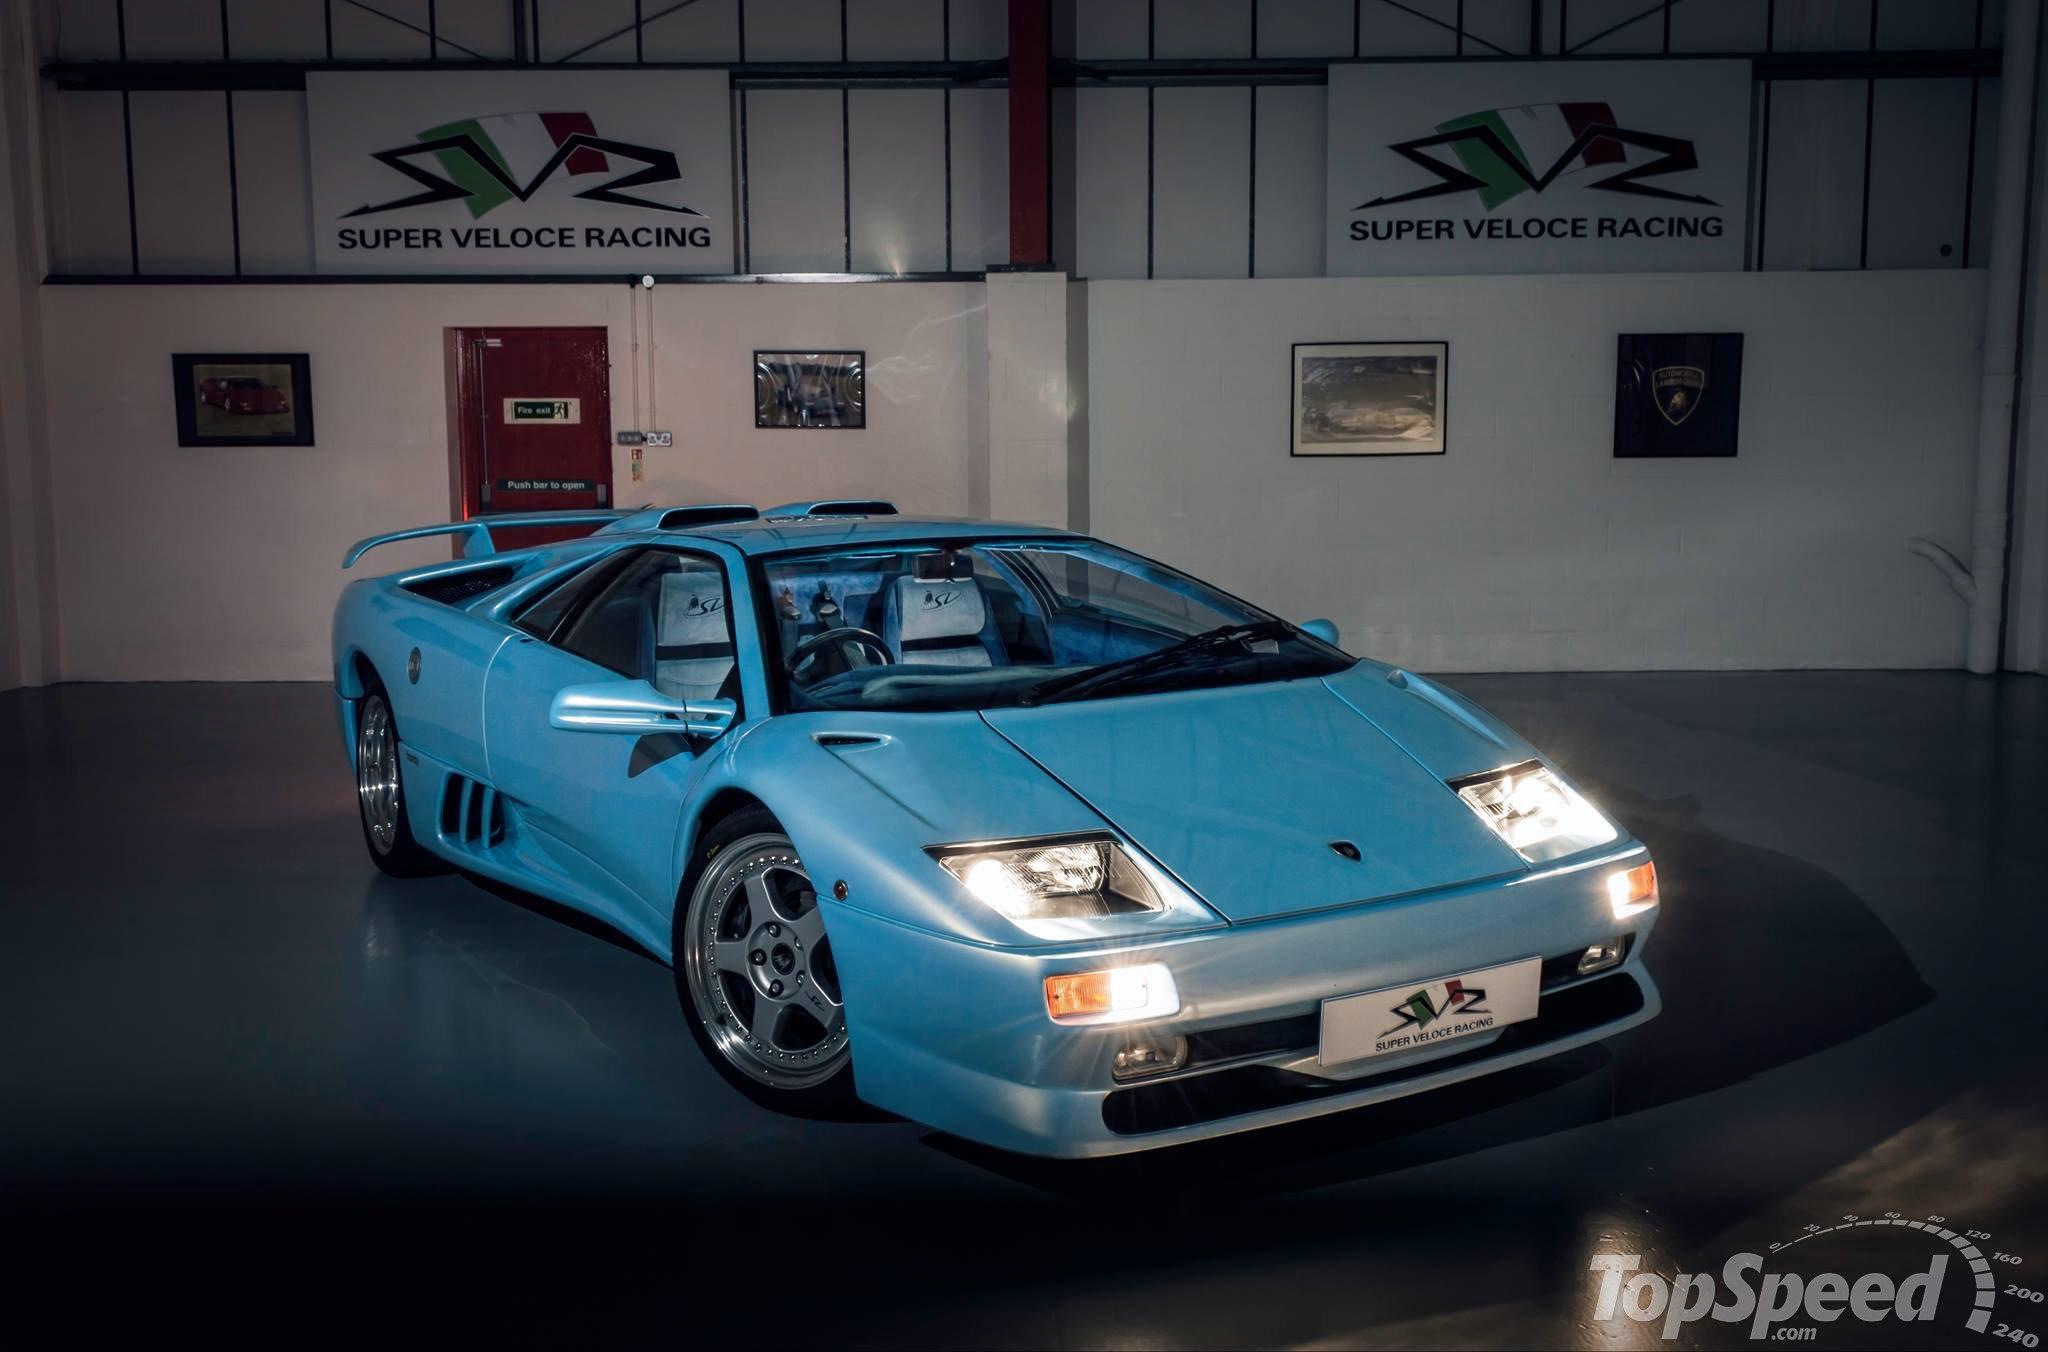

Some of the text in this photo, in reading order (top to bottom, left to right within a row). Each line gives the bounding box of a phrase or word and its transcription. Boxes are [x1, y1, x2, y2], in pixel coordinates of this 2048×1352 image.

[337, 227, 711, 249] SUPER VELOCE RACING
[1349, 216, 1723, 241] SUPER VELOCE RACING
[517, 406, 551, 415] Fire exit
[507, 480, 585, 491] Push bar to open
[1375, 1017, 1493, 1052] SUPER VELOCE RACING
